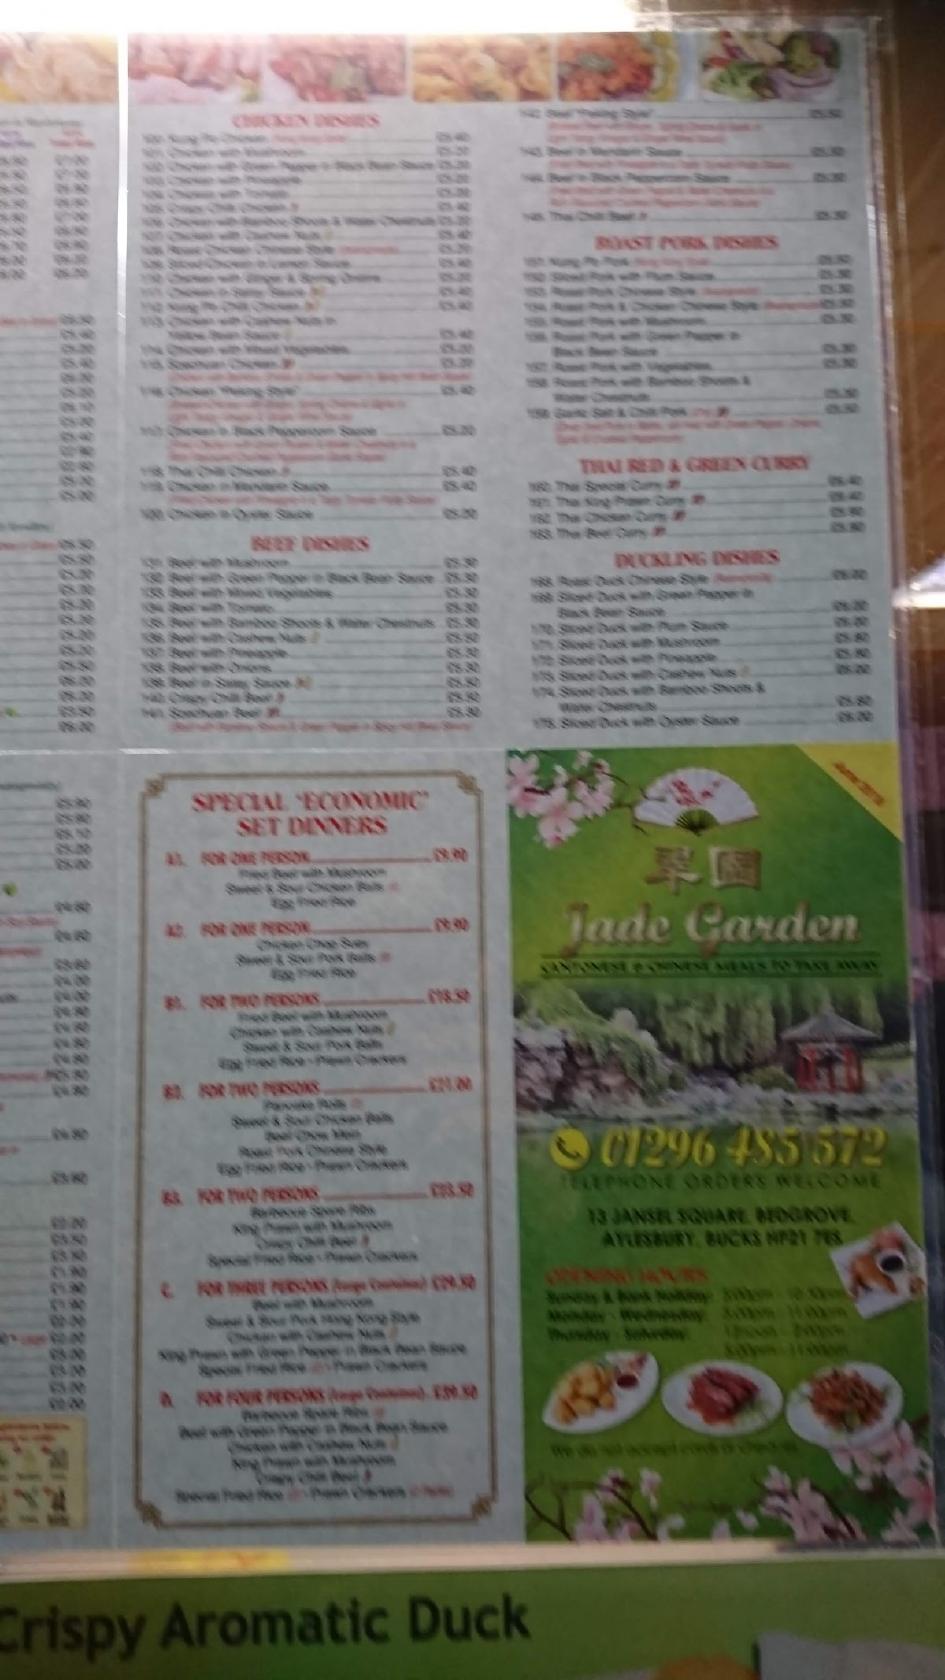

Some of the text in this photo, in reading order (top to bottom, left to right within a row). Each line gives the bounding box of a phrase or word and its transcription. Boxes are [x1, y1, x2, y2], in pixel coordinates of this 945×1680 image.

[594, 234, 779, 251] ROAST PORK DISHES
[580, 458, 623, 474] THAI
[627, 457, 665, 473] RED
[686, 456, 747, 473] GREEN
[751, 455, 809, 471] CURRY
[252, 535, 370, 552] BEEF DISHES
[614, 550, 781, 569] DUCKLING DISHES
[192, 791, 284, 813] SPECIAL
[237, 815, 388, 837] SET DINNERS
[560, 900, 861, 960] Jade Garden
[602, 1123, 888, 1169] 01296 485 572
[561, 1171, 881, 1191] TELEPHONE ORDERS WELCOME
[0, 1592, 532, 1663] Crispy Aromatic Duck
